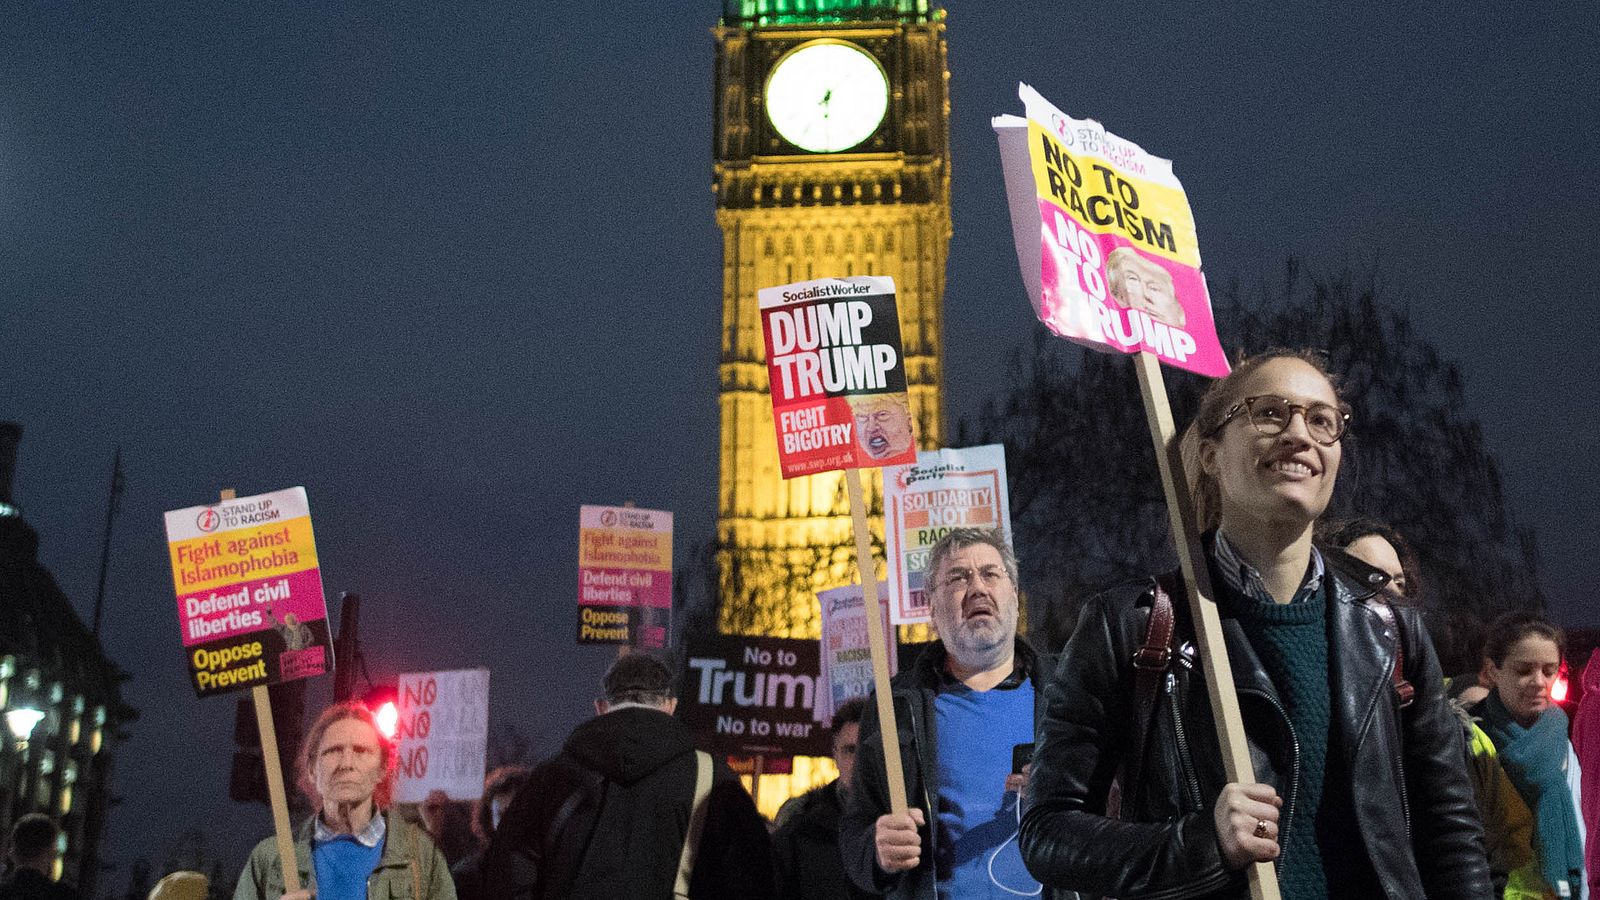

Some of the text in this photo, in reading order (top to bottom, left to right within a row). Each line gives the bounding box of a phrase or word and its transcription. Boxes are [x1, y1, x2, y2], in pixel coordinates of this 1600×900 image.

[1079, 141, 1099, 152] TO
[1042, 132, 1140, 210] NO TO
[1046, 165, 1177, 253] RACISM
[1054, 210, 1101, 270] NO
[1057, 246, 1107, 302] TO
[769, 300, 873, 356] DUMP
[772, 343, 897, 400] TRUMP
[780, 405, 826, 433] FIGHT
[783, 422, 852, 455] BIGOTRY
[910, 463, 965, 476] Socialist
[222, 499, 273, 517] STAND UP
[903, 488, 991, 512] SOLIDARITY
[224, 509, 280, 527] TO RACISM
[928, 506, 969, 527] NOT
[177, 526, 292, 565] Fight against
[584, 531, 658, 550] Fight against
[180, 549, 299, 586] Islamophobia
[584, 549, 661, 566] Islamophobia
[583, 569, 653, 587] Defend civil
[186, 578, 291, 618] Defend civil
[582, 585, 632, 602] liberties
[188, 610, 263, 640] liberties
[582, 607, 629, 626] Oppose
[581, 624, 629, 640] Prevent
[193, 640, 263, 671] Oppose
[743, 646, 798, 666] No to
[196, 659, 267, 690] Prevent
[716, 715, 813, 738] No to war
